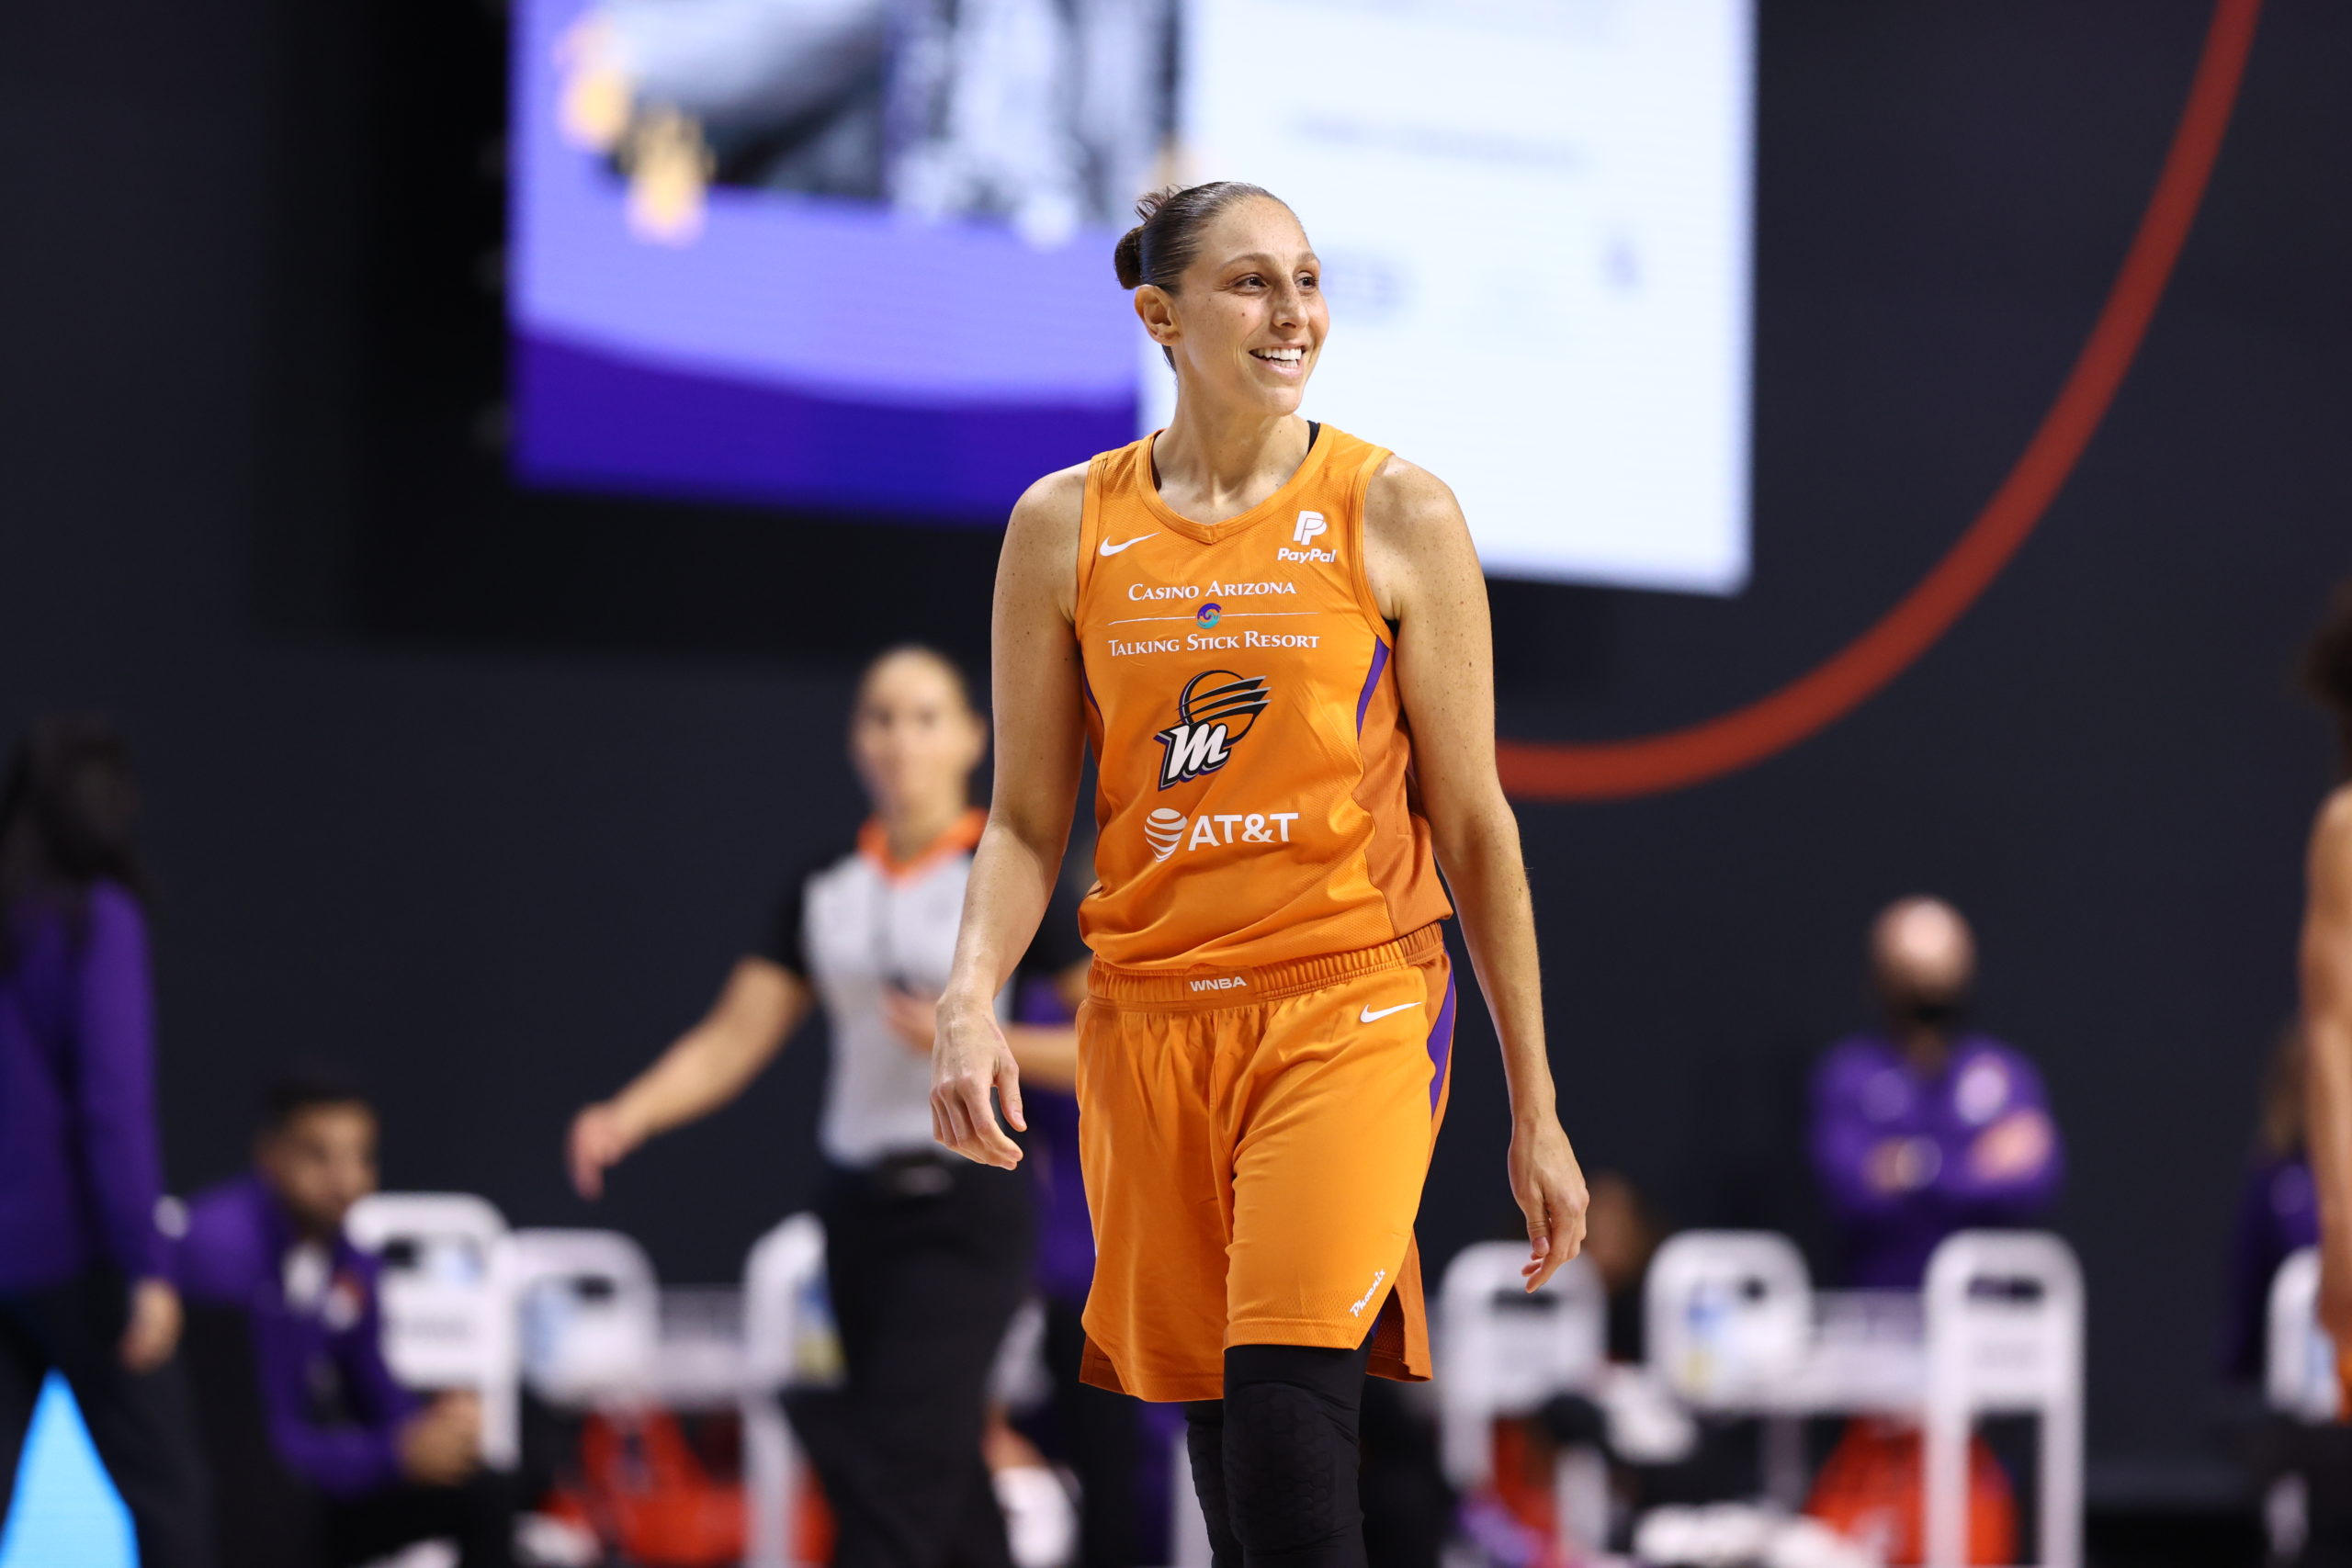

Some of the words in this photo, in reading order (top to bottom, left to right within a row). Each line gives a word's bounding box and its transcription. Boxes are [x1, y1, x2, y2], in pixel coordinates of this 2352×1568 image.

[1277, 547, 1337, 564] PayPal
[1128, 583, 1200, 602] CASINO
[1205, 581, 1297, 598] ARIZONA
[1108, 638, 1181, 658] TALKING
[1187, 634, 1240, 651] STICK
[1244, 631, 1320, 649] RESORT
[1188, 812, 1299, 852] AT&T
[1190, 976, 1248, 992] WNBA
